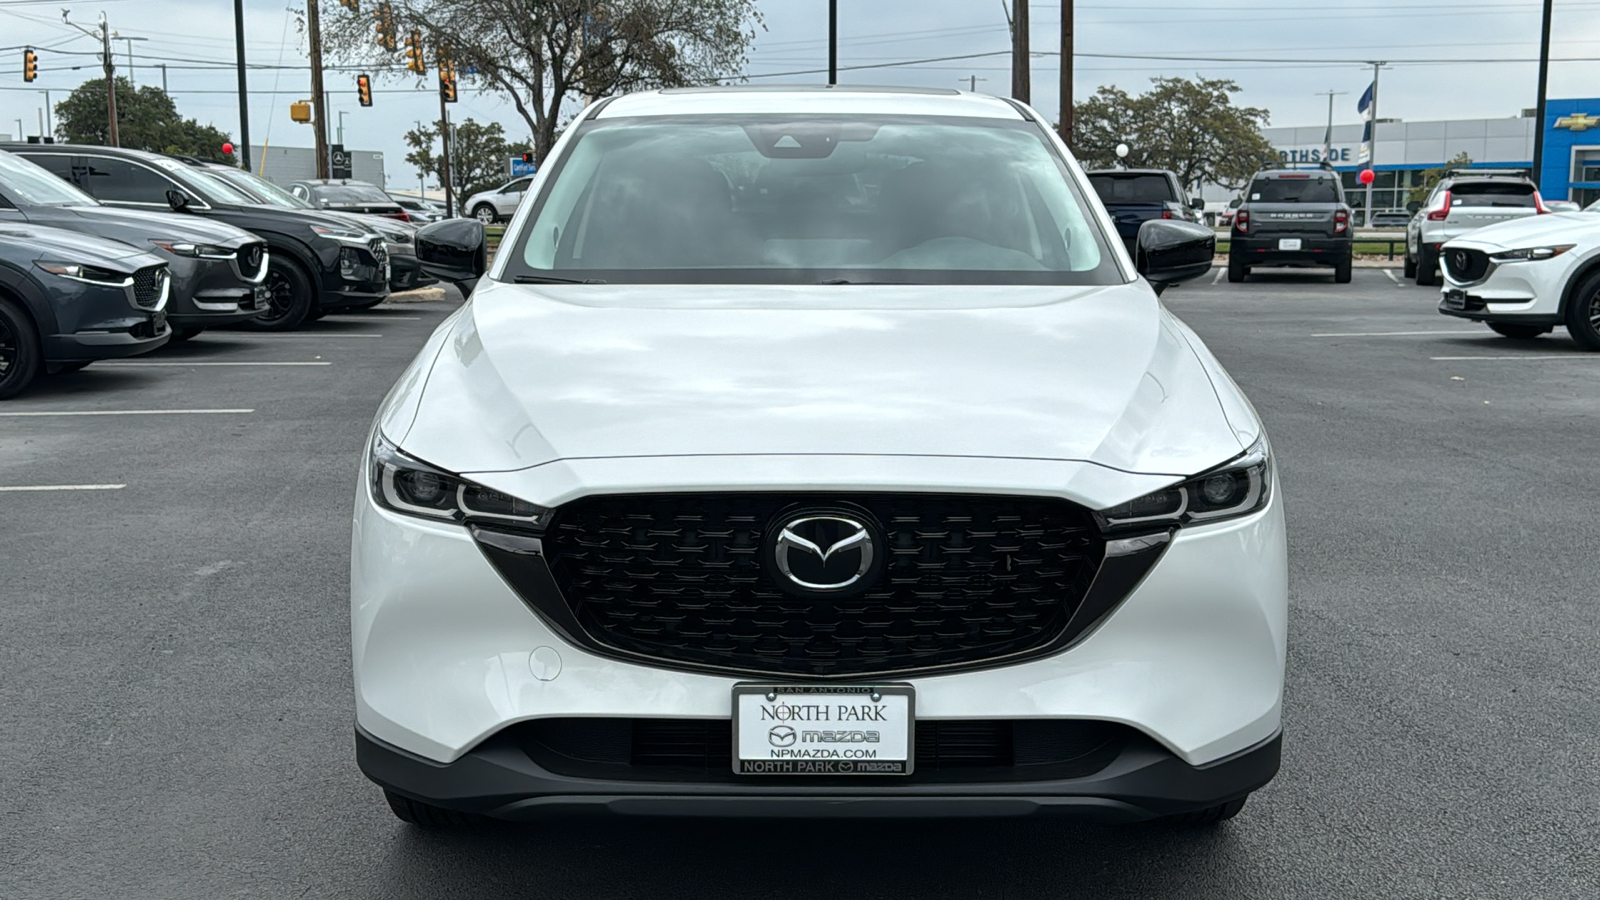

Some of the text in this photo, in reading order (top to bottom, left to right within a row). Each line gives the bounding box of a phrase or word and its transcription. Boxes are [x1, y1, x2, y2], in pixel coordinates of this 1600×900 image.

[1262, 148, 1351, 162] RTHSDE
[760, 704, 887, 722] NORTH PARK
[802, 730, 880, 743] mazda
[770, 749, 877, 758] NPMAZDA.COM
[744, 761, 902, 772] NORTH PARK mazda
